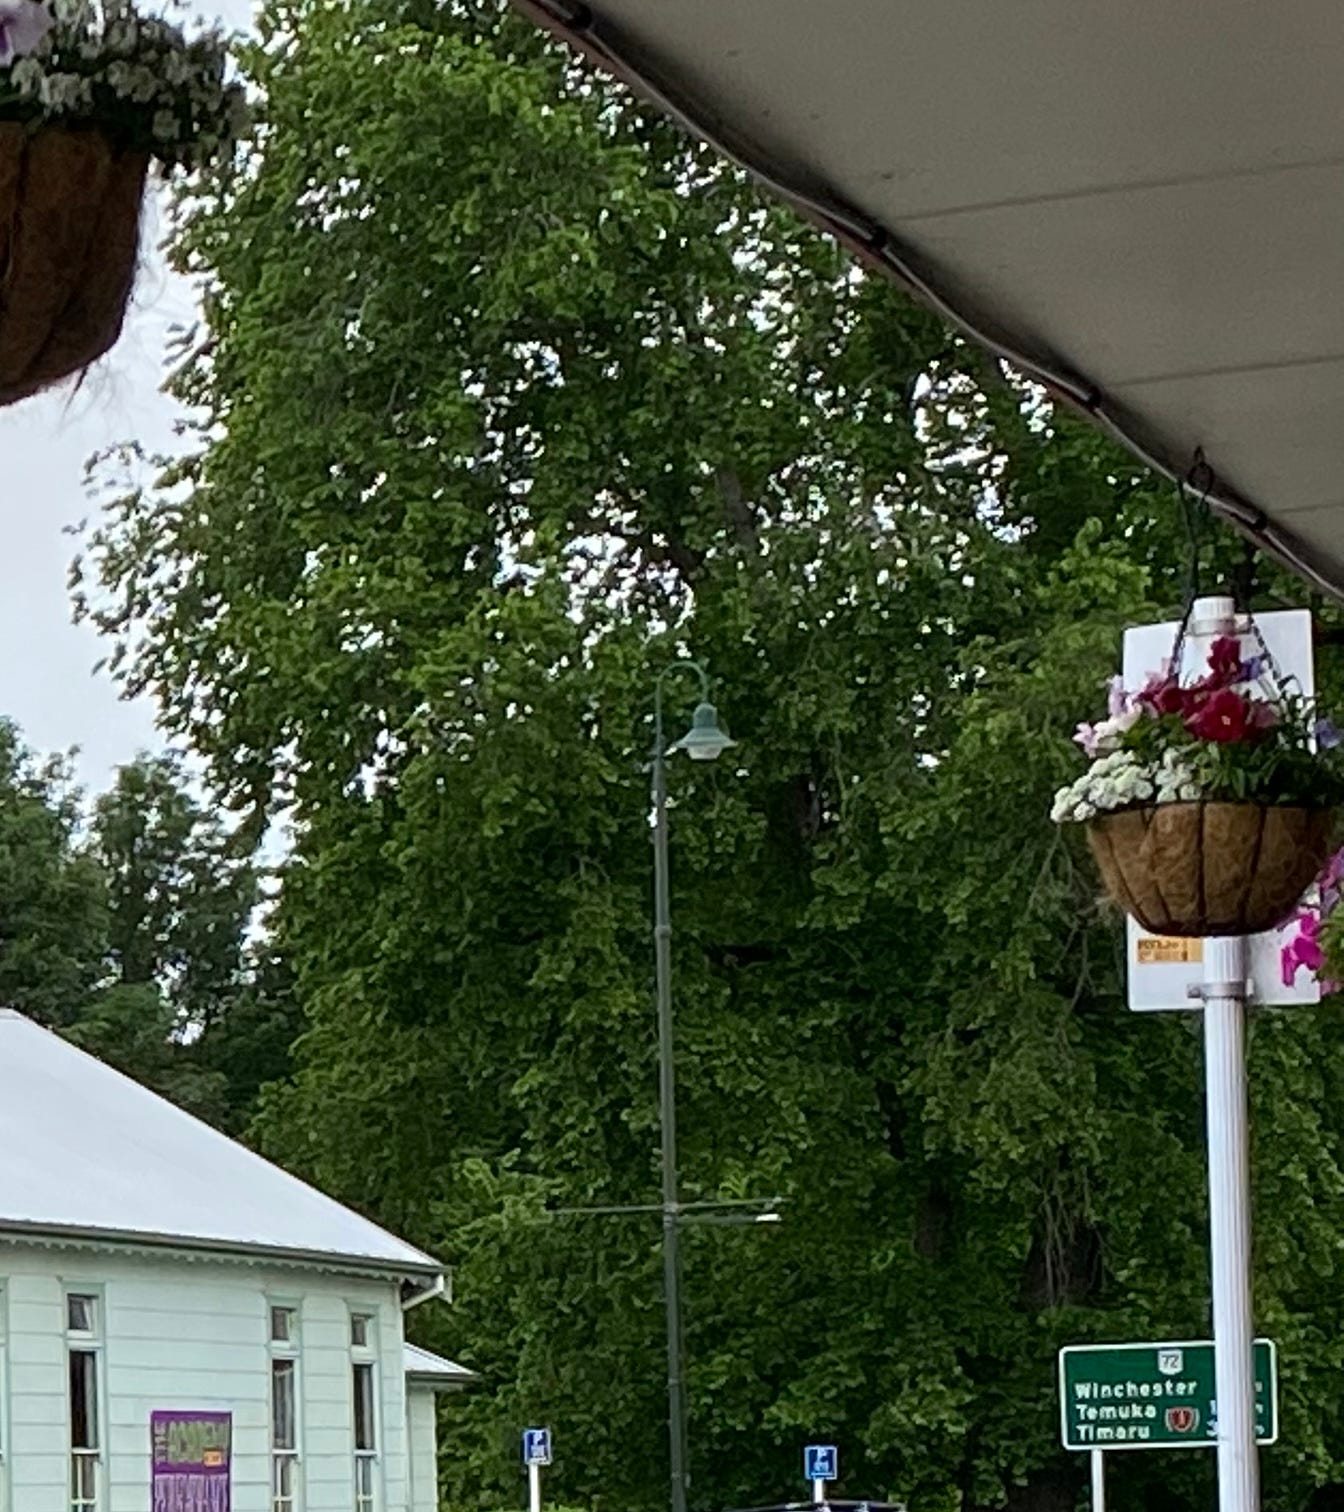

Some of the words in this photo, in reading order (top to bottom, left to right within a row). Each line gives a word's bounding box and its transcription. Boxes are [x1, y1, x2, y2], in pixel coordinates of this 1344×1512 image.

[1074, 1379, 1198, 1399] Winchester
[1075, 1403, 1157, 1420] Temuka
[1076, 1424, 1151, 1441] Timaru
